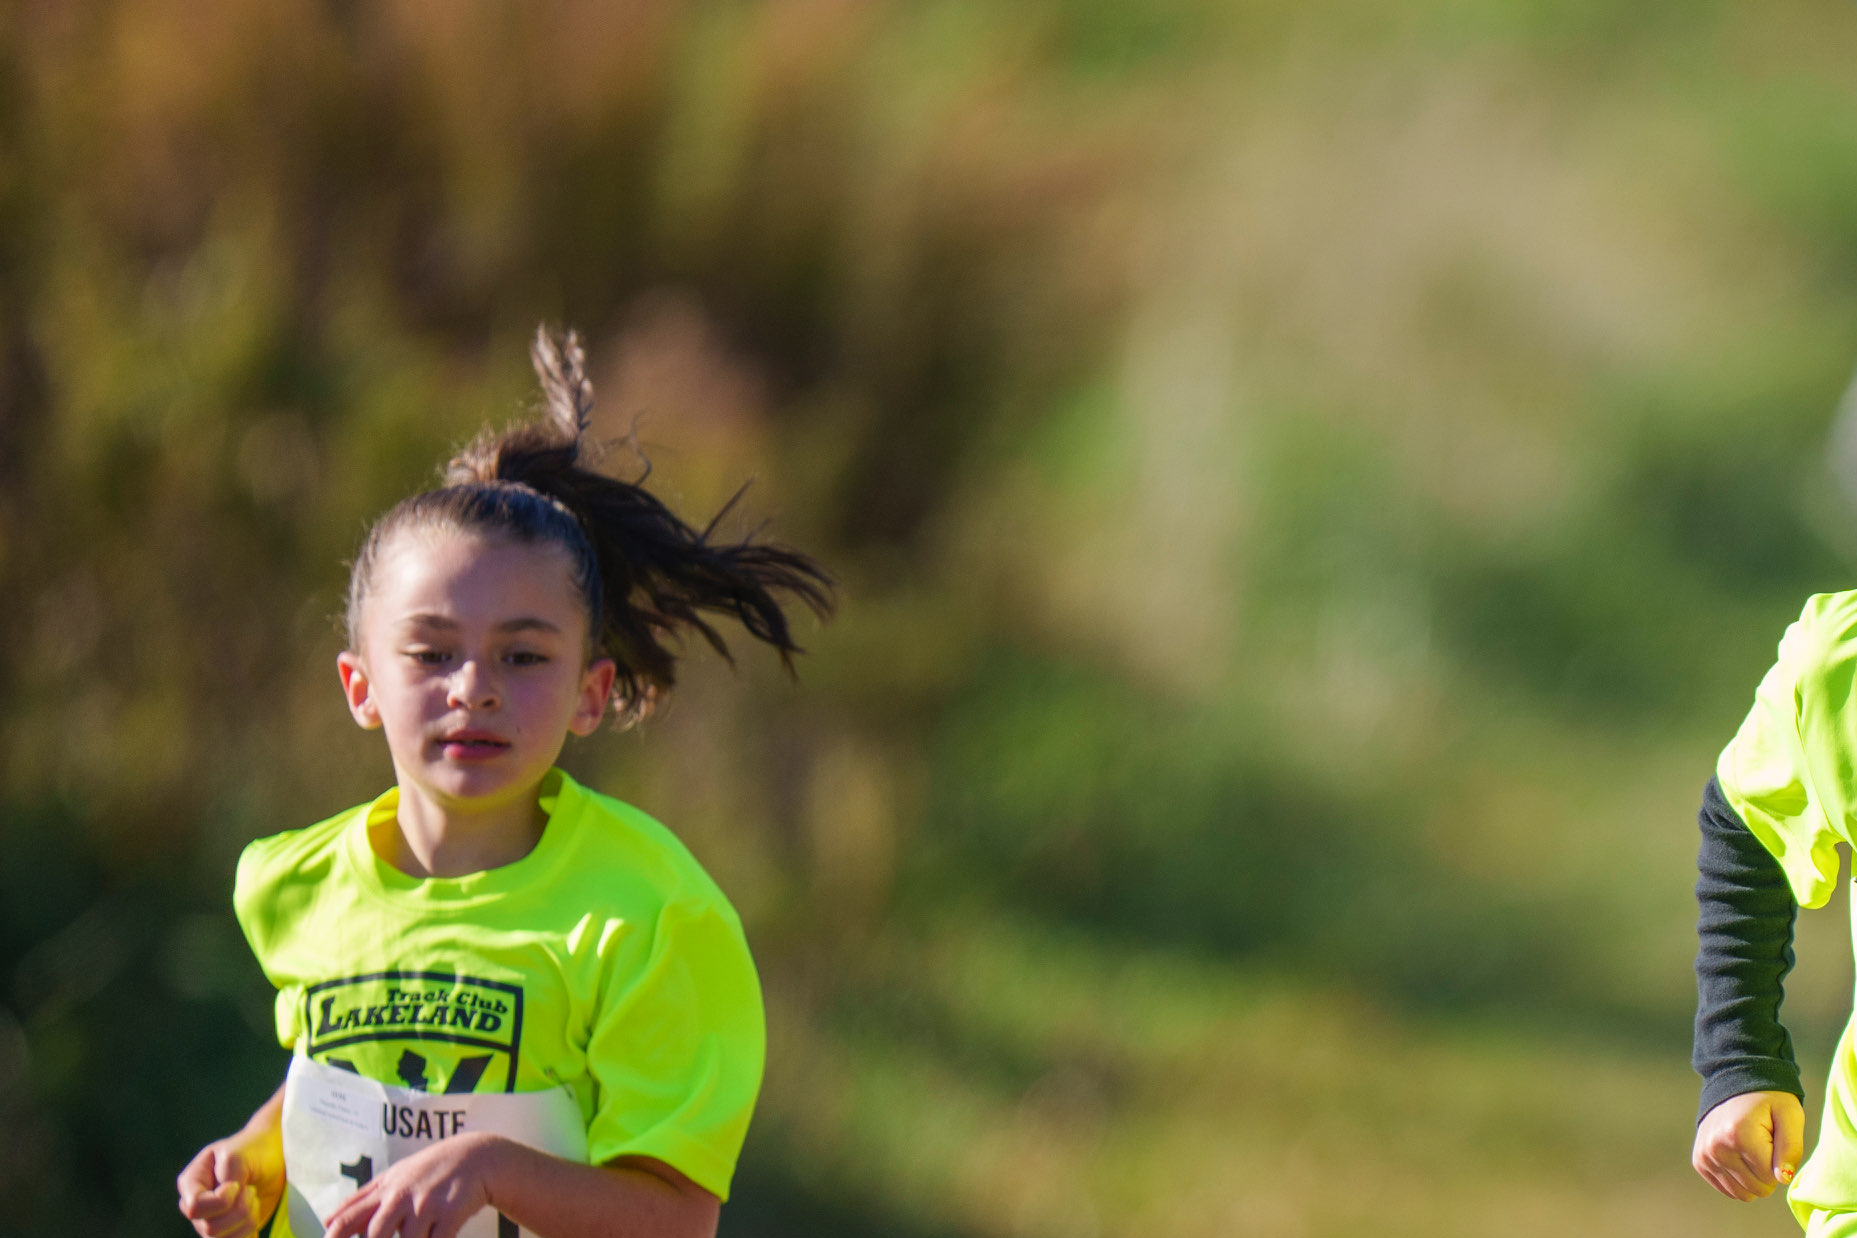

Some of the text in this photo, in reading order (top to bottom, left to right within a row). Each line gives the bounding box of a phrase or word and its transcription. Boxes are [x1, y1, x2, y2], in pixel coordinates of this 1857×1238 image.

[316, 996, 502, 1037] LAKELAND
[388, 988, 508, 1014] Track Club
[383, 1103, 466, 1139] USATF
